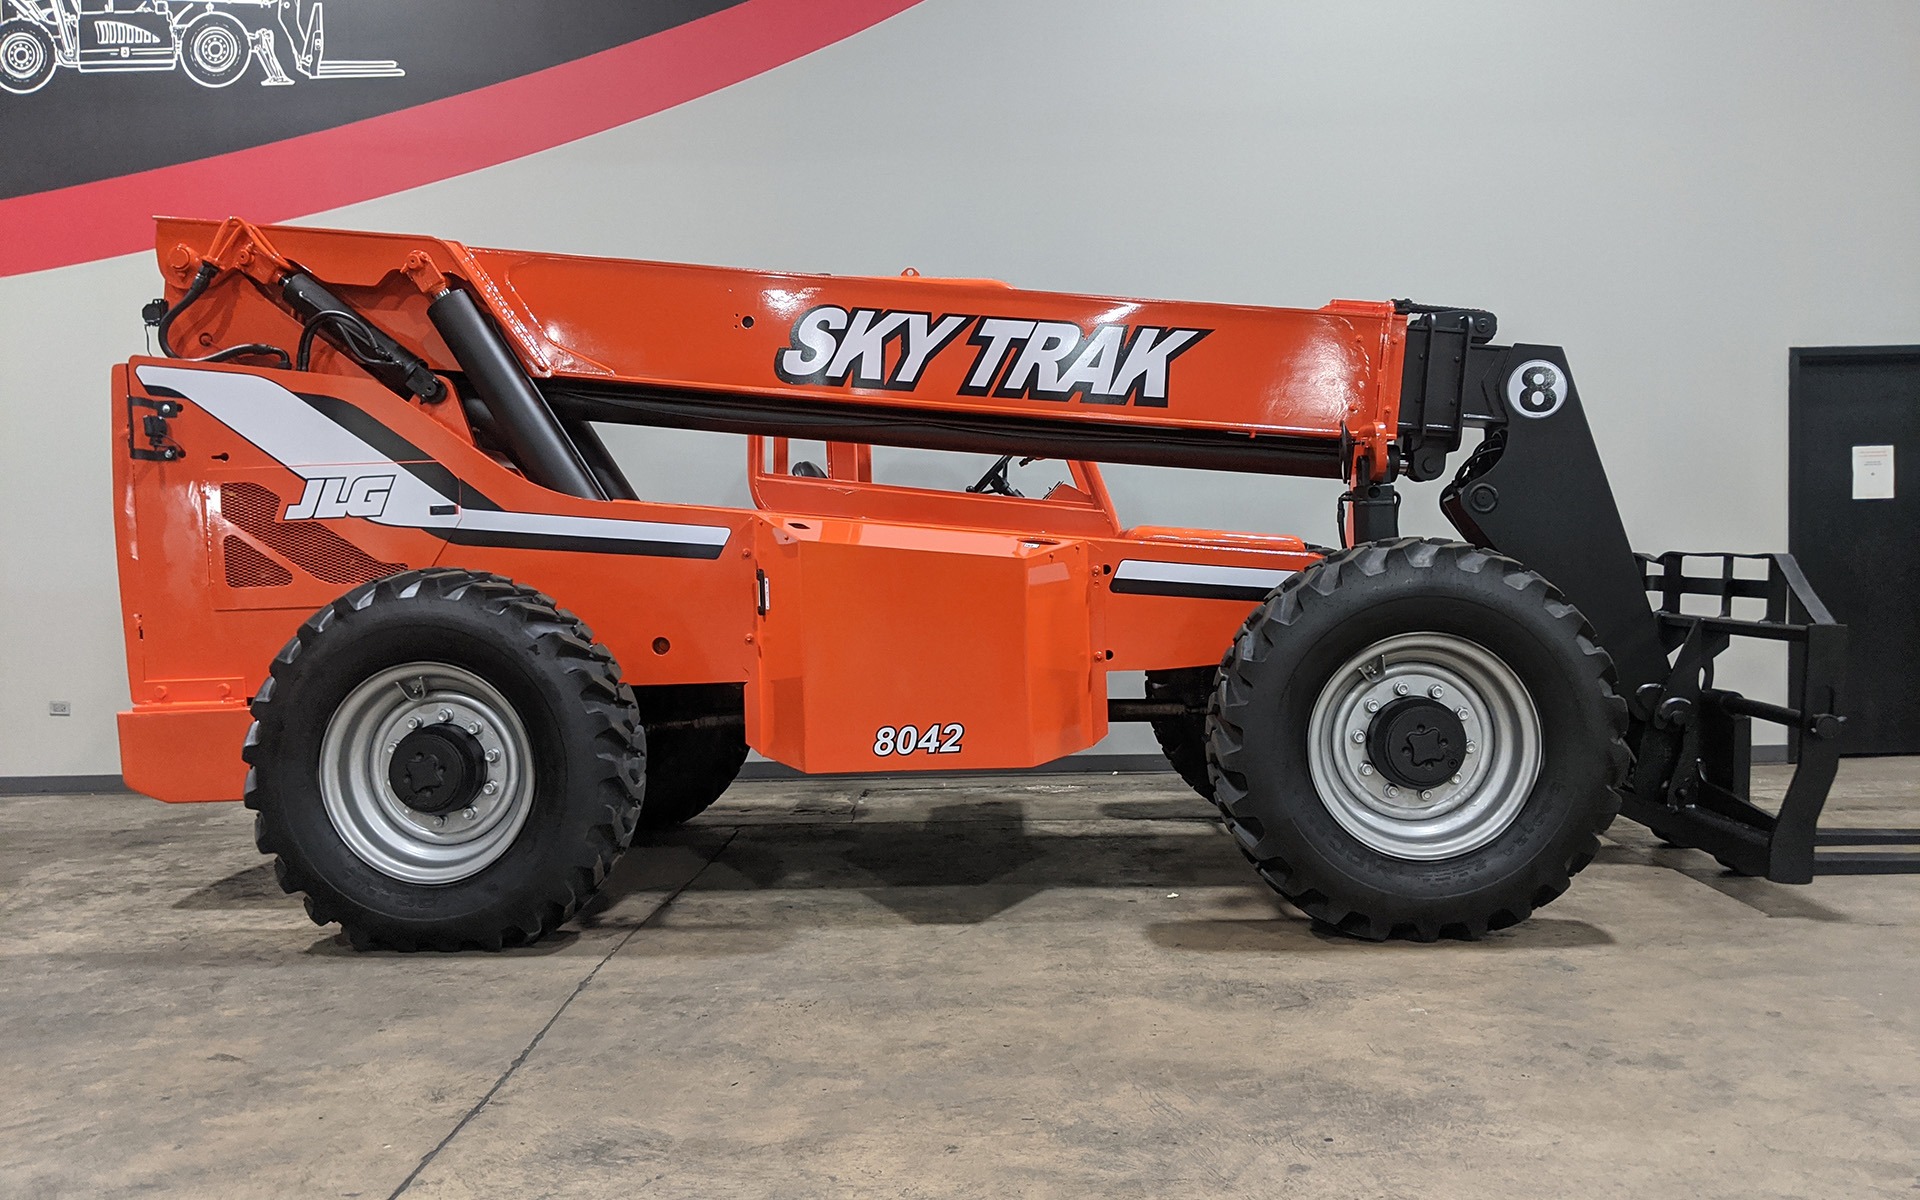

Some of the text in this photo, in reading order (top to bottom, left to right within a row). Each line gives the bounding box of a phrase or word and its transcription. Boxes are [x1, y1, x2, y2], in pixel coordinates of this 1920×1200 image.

[777, 305, 1209, 404] SKY TRAK
[1519, 366, 1557, 413] 8
[283, 475, 397, 521] JLG
[873, 722, 965, 757] 8042
